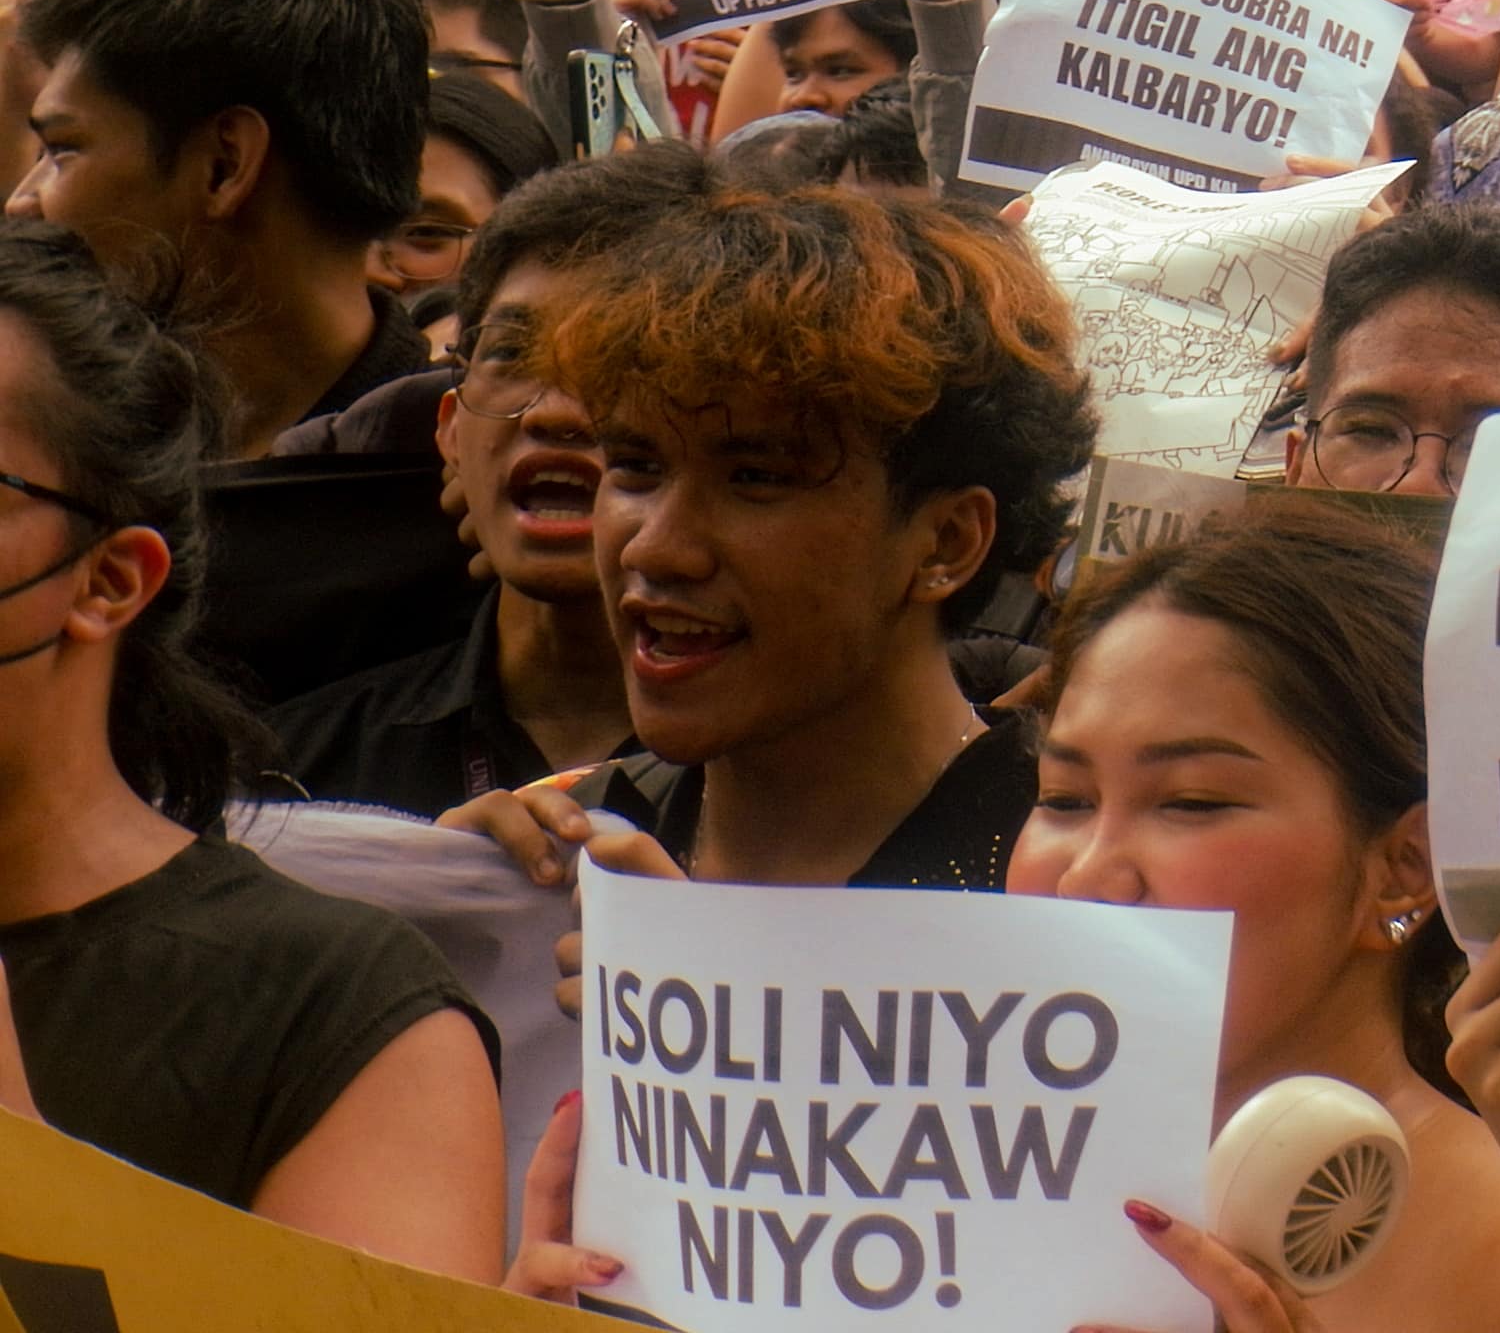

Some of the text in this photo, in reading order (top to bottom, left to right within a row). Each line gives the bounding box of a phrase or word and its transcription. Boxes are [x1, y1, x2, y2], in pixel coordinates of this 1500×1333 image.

[1057, 42, 1298, 150] KALBARYO!
[1214, 28, 1308, 94] ANG
[1317, 17, 1375, 69] NA!
[598, 963, 1120, 1090] ISOLI NIYO
[611, 1073, 1097, 1202] NINAKAW
[677, 1199, 964, 1313] NIYO!
